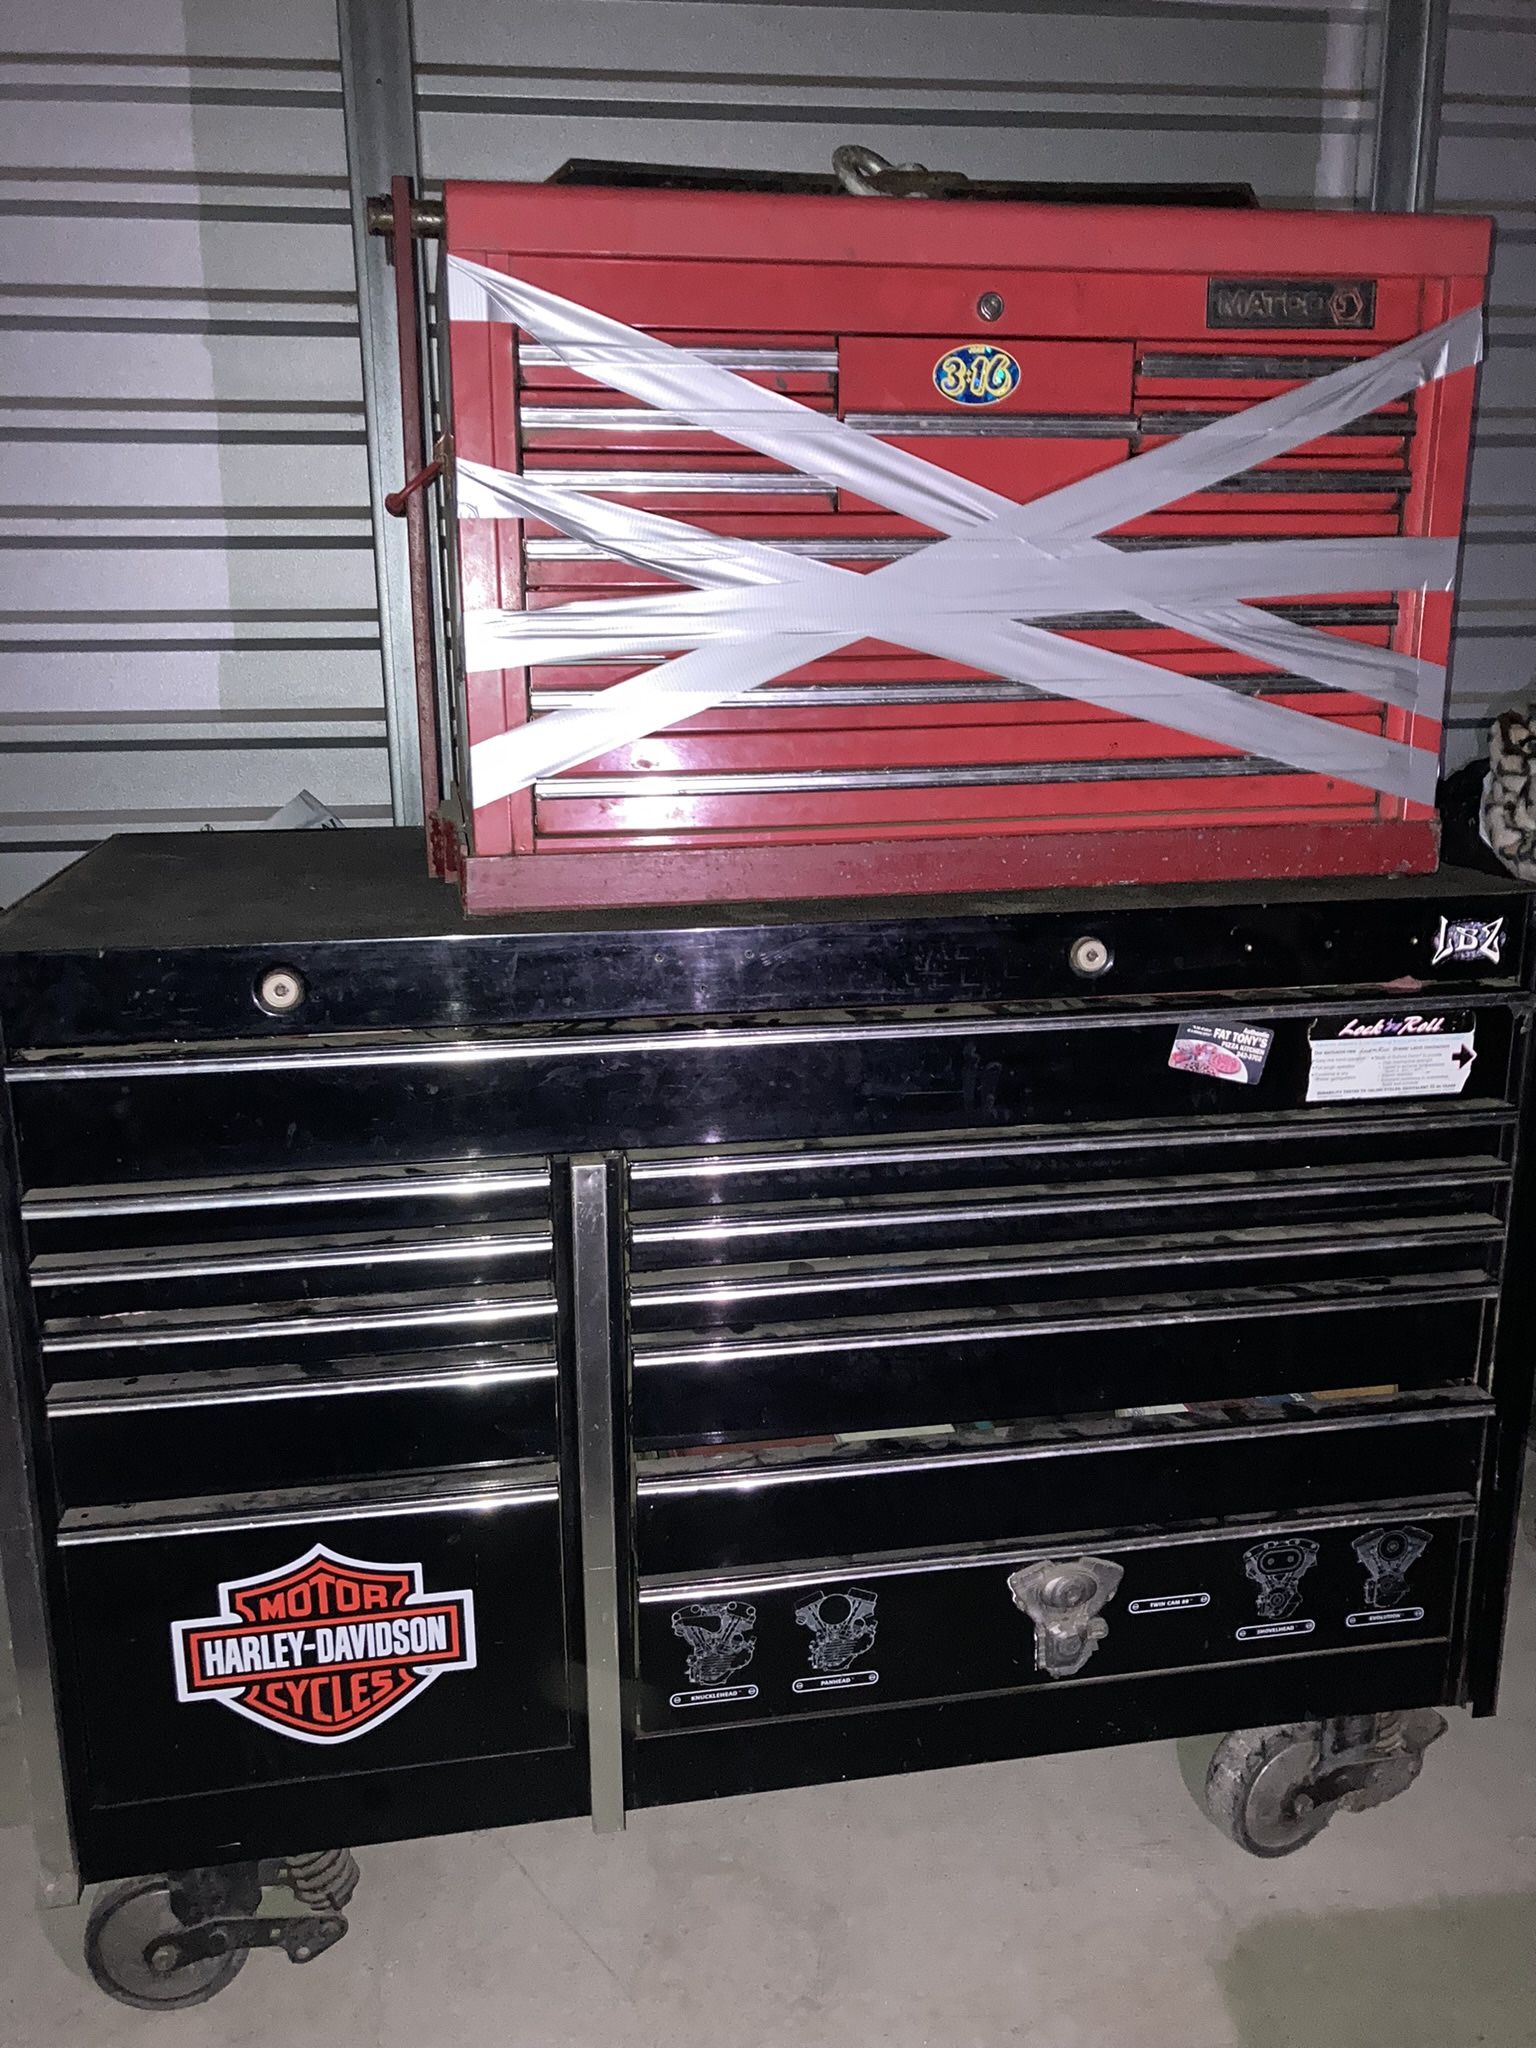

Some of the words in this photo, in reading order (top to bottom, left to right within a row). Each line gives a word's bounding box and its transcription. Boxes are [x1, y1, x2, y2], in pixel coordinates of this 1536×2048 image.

[940, 353, 1012, 397] 3:16
[1432, 915, 1504, 965] LBZ
[1213, 1027, 1231, 1040] FAT
[1232, 1031, 1268, 1048] TONY'S
[1338, 1018, 1385, 1037] Lock
[1397, 1015, 1445, 1035] Roll
[1221, 1041, 1239, 1051] PIZZA
[1239, 1044, 1265, 1056] KITCHEN
[259, 1572, 388, 1621] MOTOR
[203, 1615, 447, 1677] HARLEY-DAVIDSON
[266, 1669, 394, 1723] CYCLES
[690, 1689, 738, 1701] KNUCKLEHEAD
[820, 1676, 851, 1686] PANHEAD
